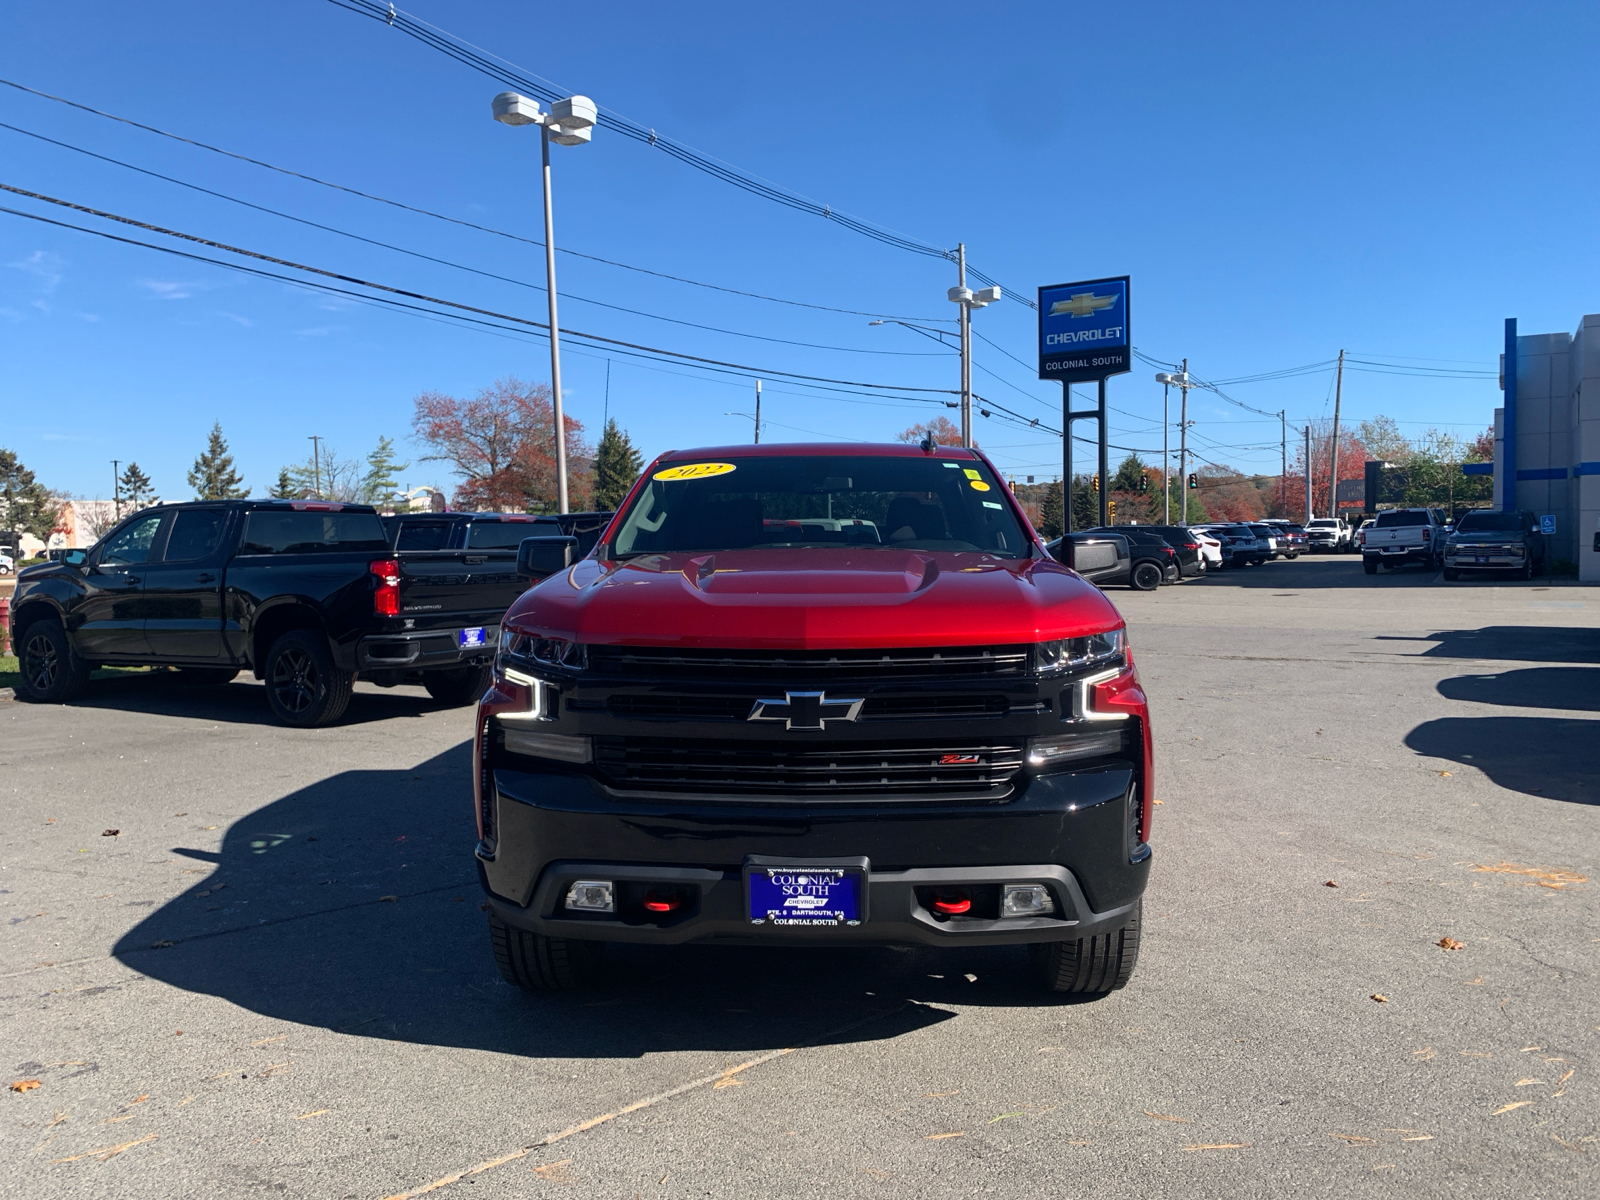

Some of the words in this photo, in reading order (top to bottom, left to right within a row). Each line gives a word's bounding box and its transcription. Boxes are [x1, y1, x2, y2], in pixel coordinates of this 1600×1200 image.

[1046, 327, 1122, 345] CHEVROLET
[1045, 359, 1089, 371] COLONIAL
[1092, 356, 1122, 366] SOUTH
[667, 464, 724, 478] 2022
[771, 875, 840, 885] COLONIAL
[782, 885, 829, 895] SOUTH
